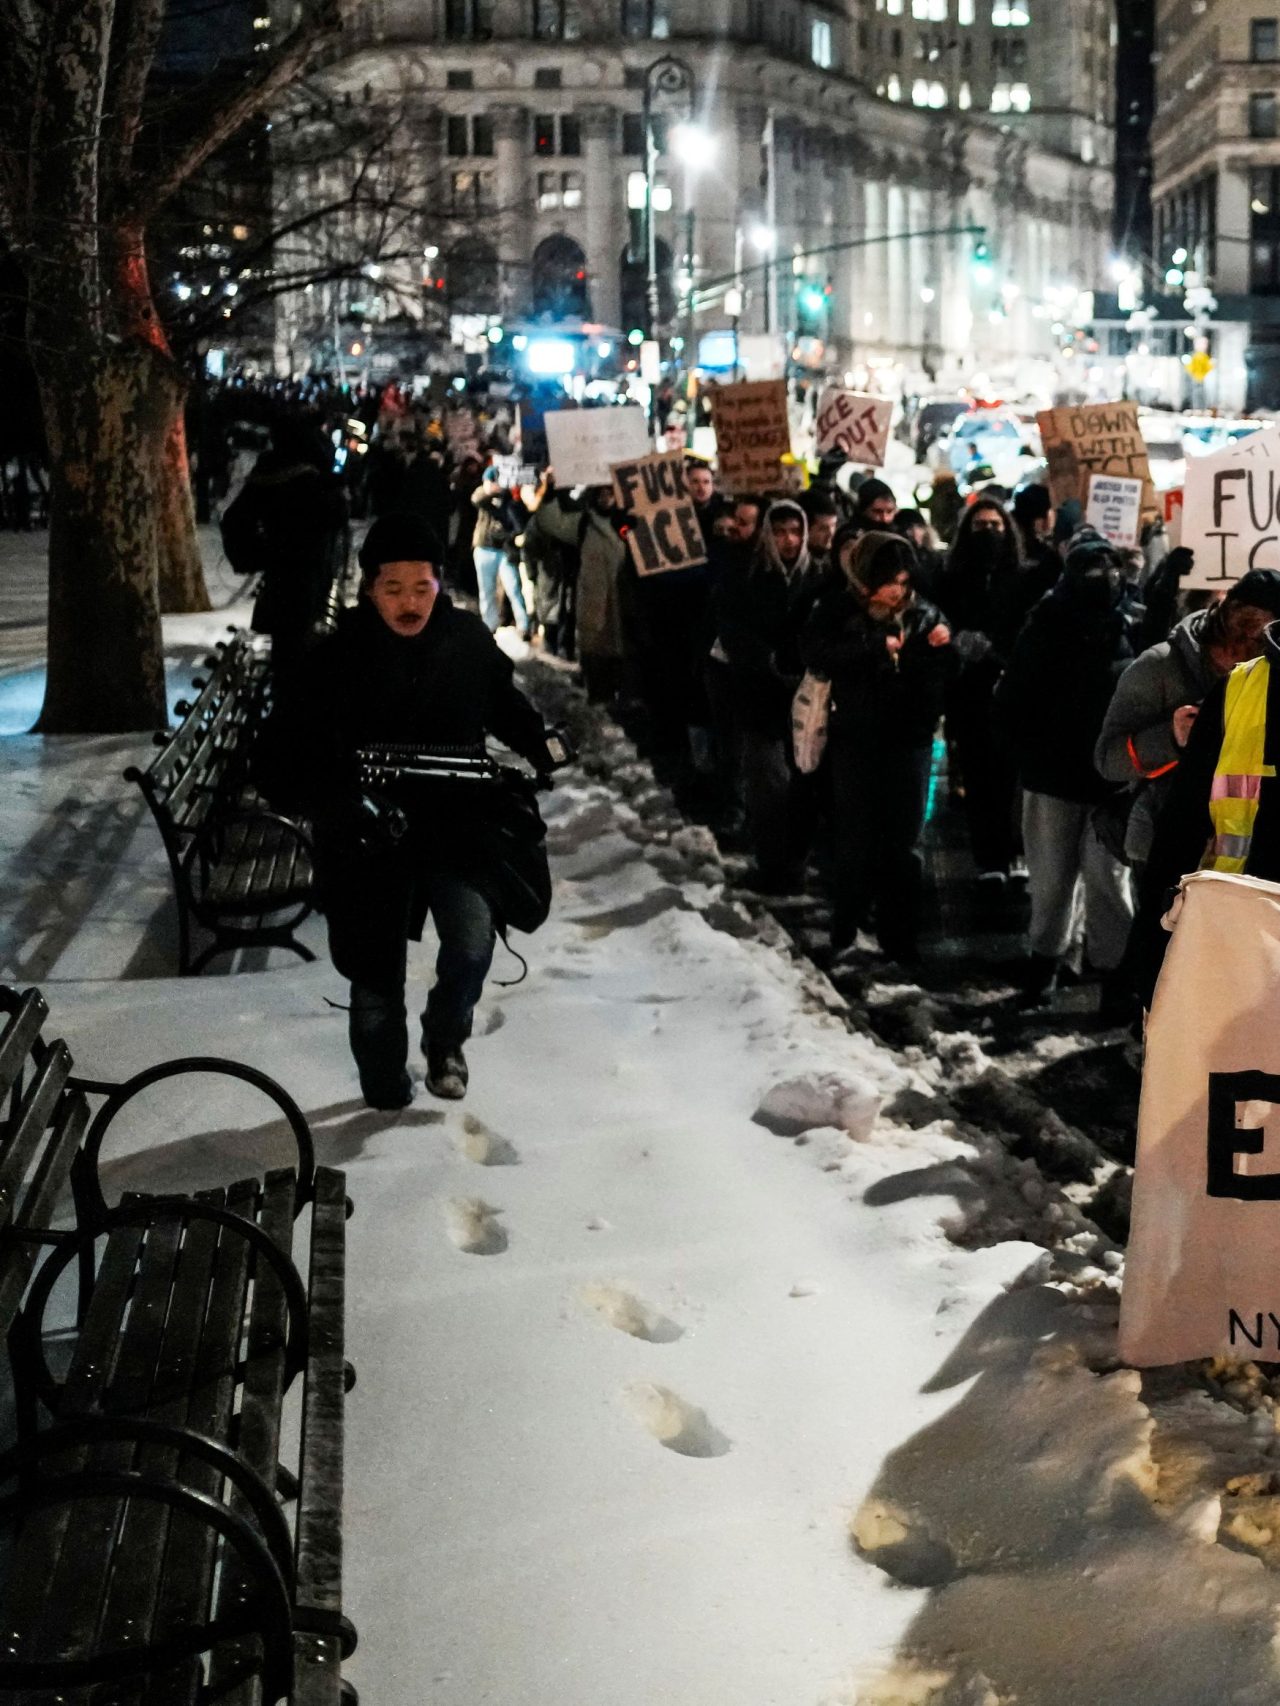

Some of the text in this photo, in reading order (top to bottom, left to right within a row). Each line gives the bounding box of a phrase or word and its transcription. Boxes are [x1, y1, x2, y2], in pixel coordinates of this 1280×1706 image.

[816, 394, 854, 447] ICE
[834, 406, 880, 448] OUT
[1070, 409, 1140, 437] DOWN
[1078, 437, 1136, 456] WITH
[616, 460, 688, 511] FUCK
[633, 507, 705, 571] ICE
